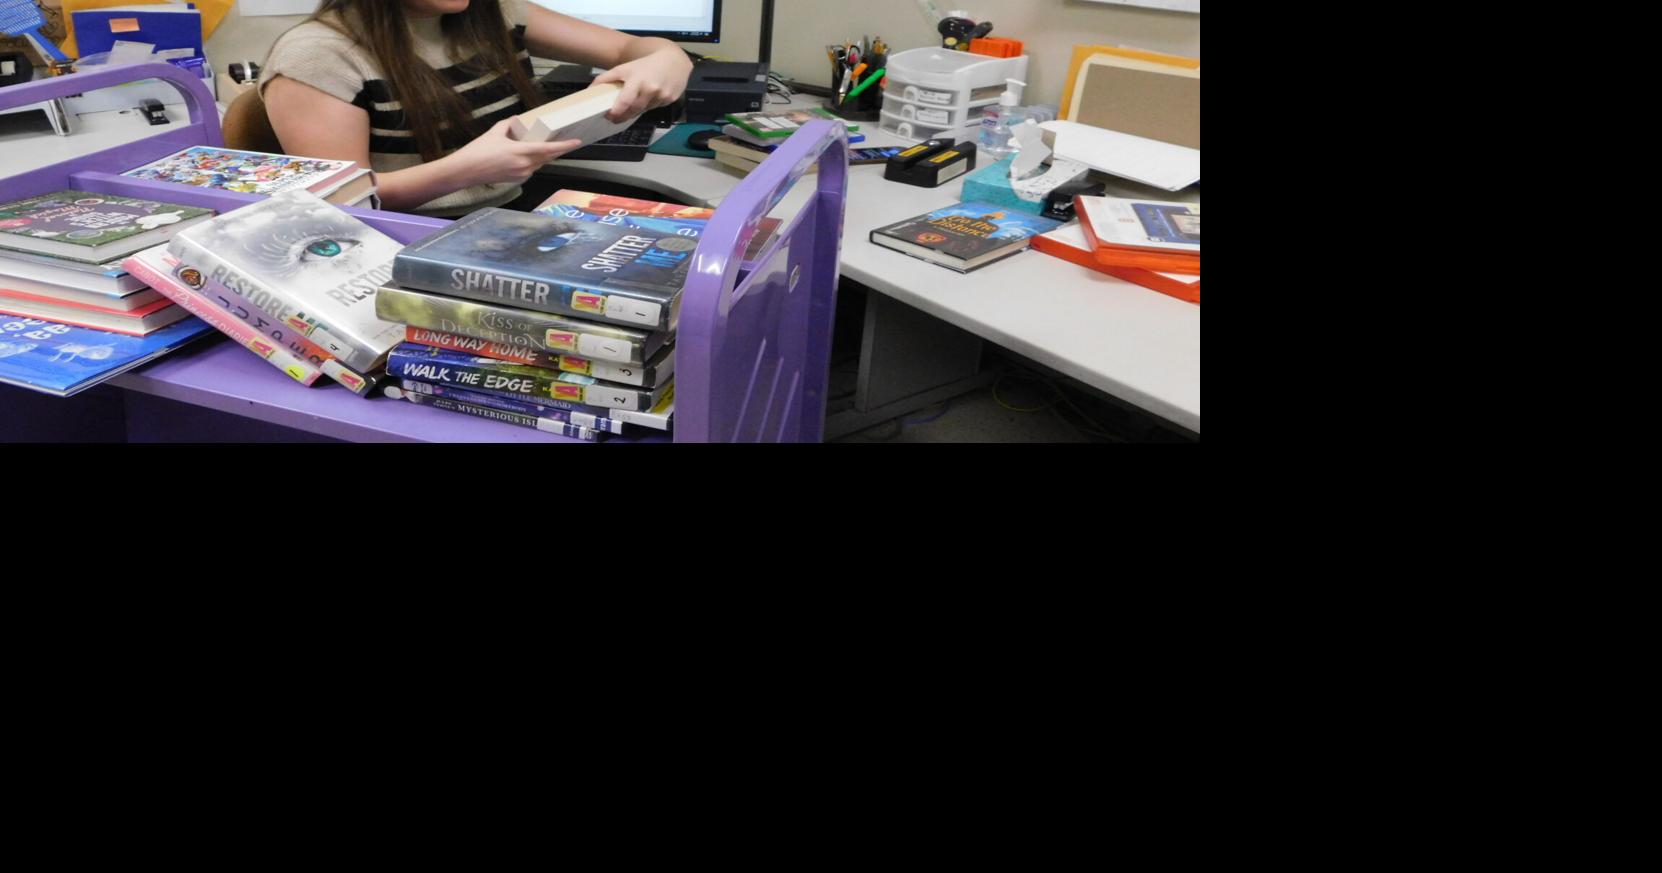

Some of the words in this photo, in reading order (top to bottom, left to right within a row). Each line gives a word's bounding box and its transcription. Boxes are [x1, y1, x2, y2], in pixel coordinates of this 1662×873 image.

[581, 235, 657, 273] SHATTER
[634, 247, 689, 268] ME
[211, 264, 294, 322] RESTORE
[325, 260, 394, 308] RESTOR
[451, 268, 550, 305] SHATTER
[218, 321, 252, 346] DIARIE
[414, 329, 450, 345] LONG
[453, 335, 488, 351] WAY
[489, 343, 538, 361] HOME
[441, 318, 546, 350] DECEPTION
[403, 363, 450, 381] WALK
[455, 371, 480, 385] THE
[484, 375, 535, 393] EDGE
[458, 404, 519, 423] MYSTERIOUS
